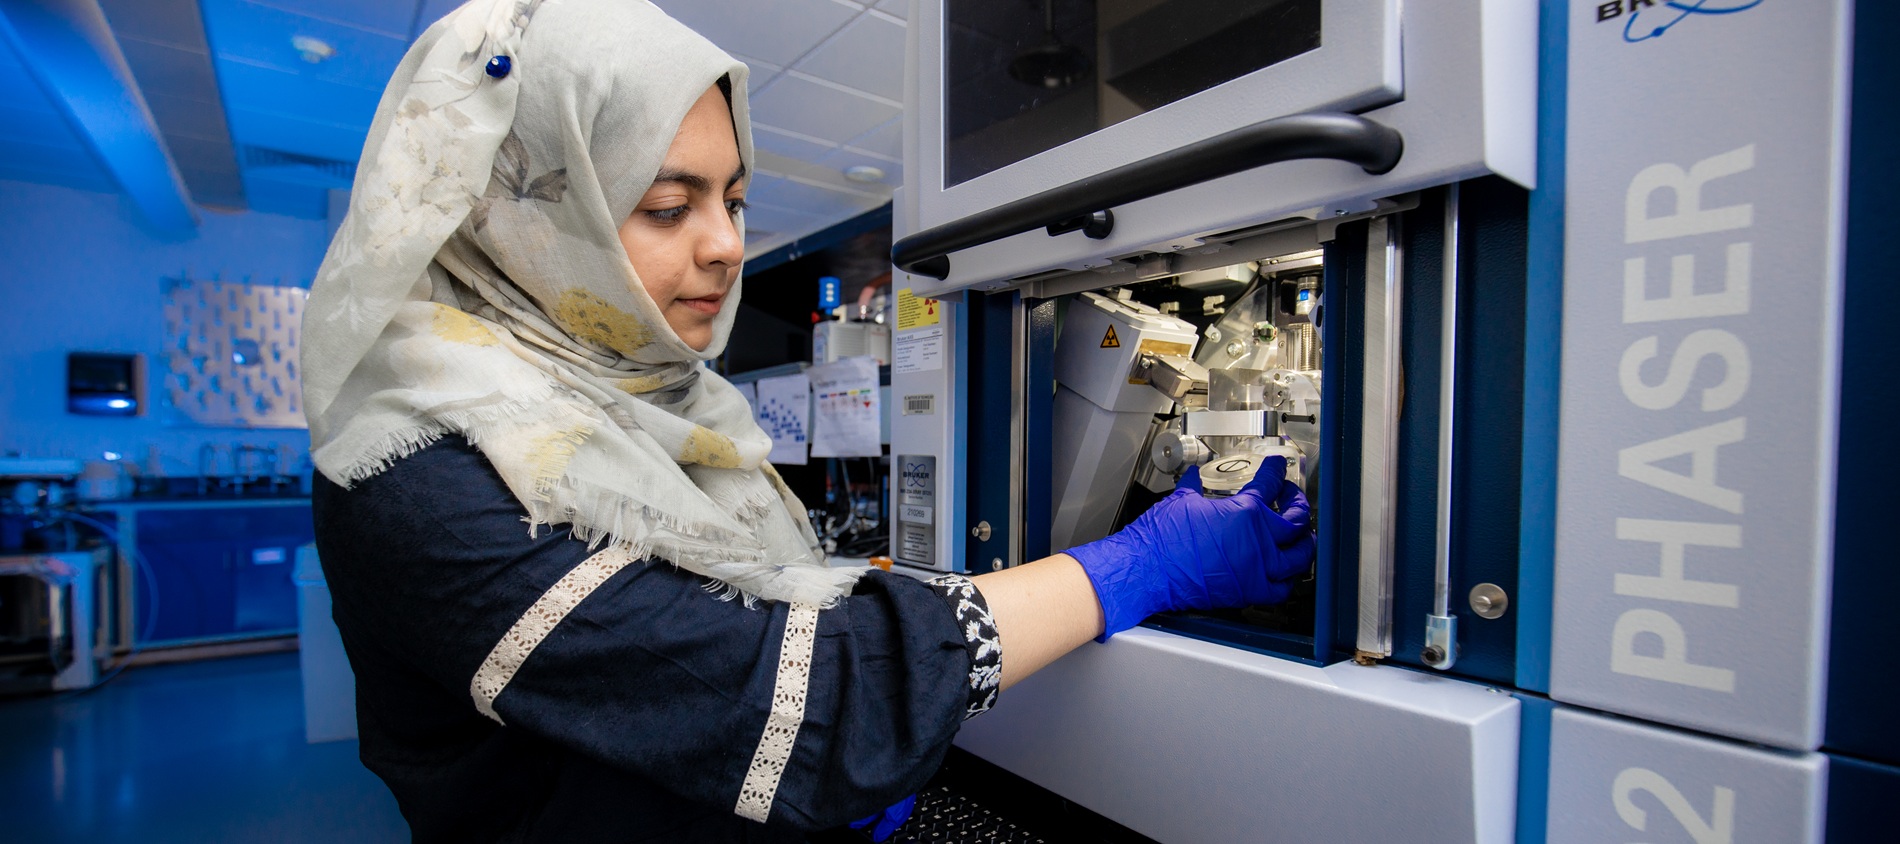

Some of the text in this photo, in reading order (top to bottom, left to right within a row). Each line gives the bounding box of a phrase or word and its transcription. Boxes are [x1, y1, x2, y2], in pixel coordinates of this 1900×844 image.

[903, 471, 930, 479] BRUKER
[1610, 142, 1756, 844] 2 PHASER
